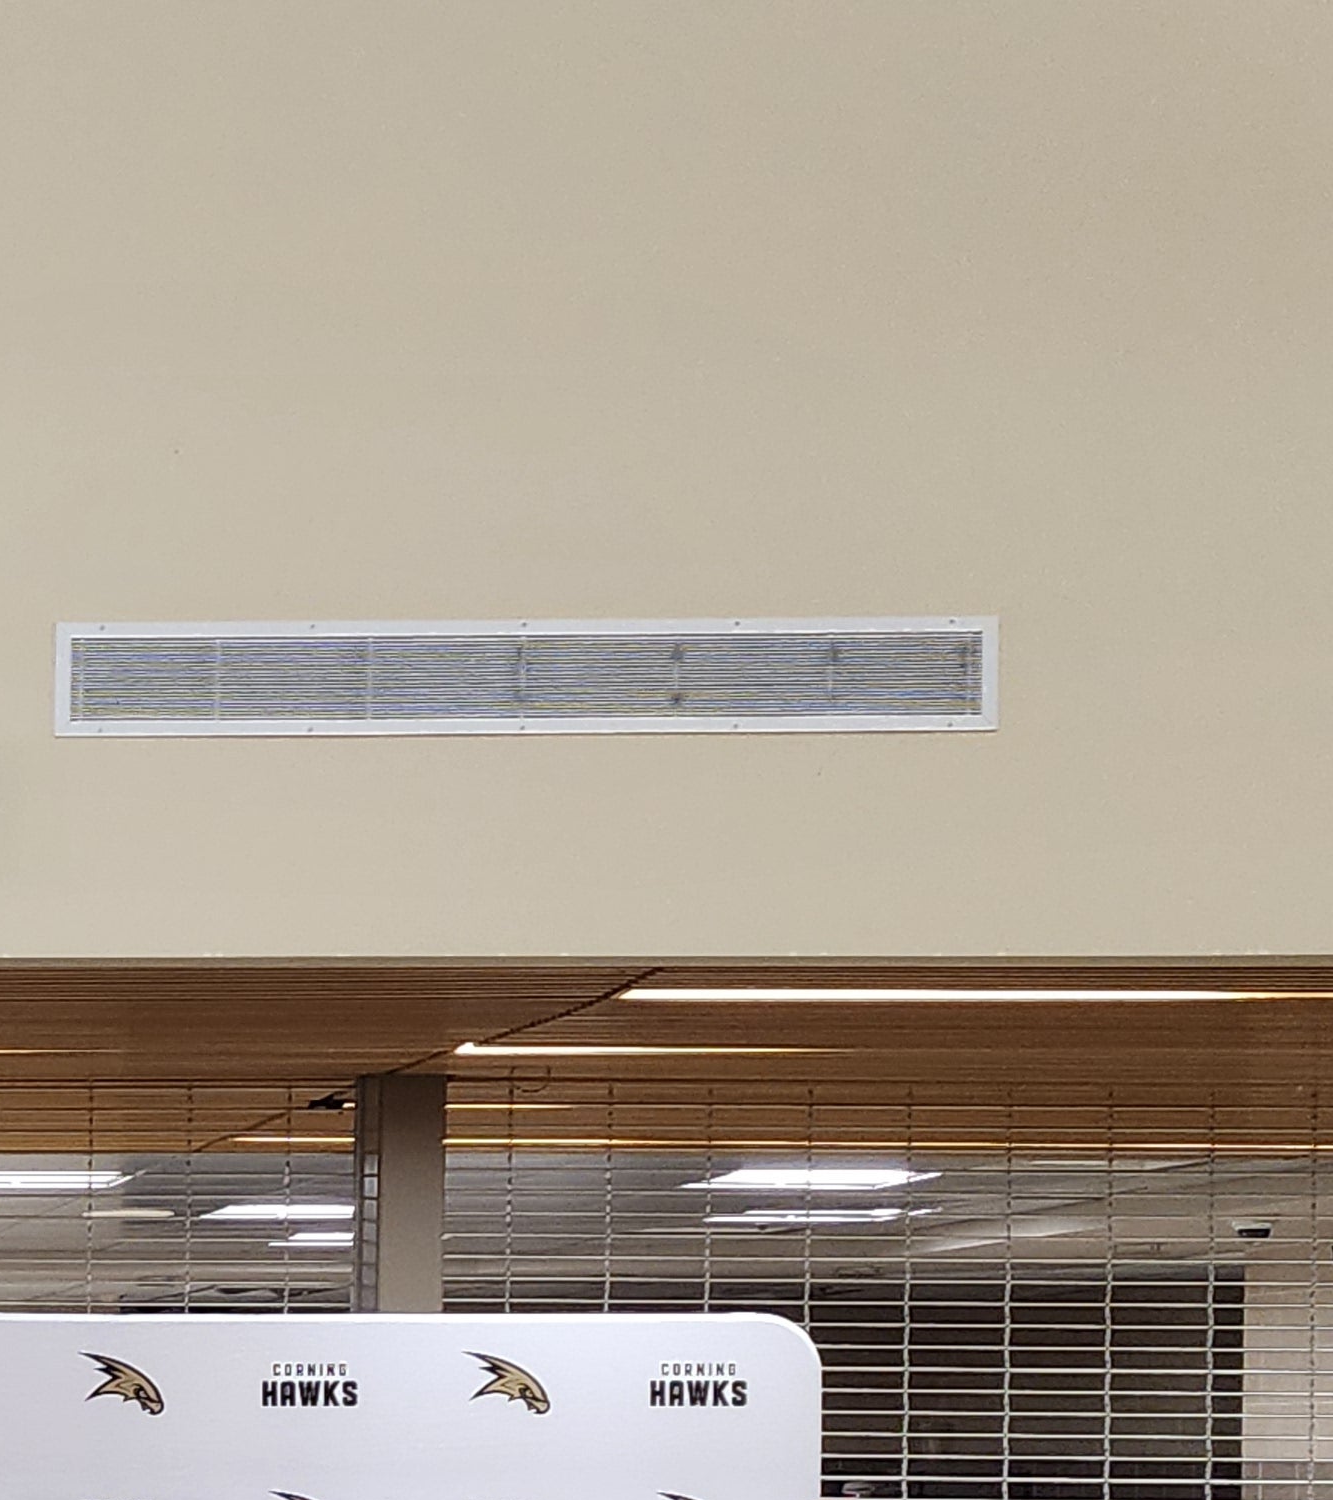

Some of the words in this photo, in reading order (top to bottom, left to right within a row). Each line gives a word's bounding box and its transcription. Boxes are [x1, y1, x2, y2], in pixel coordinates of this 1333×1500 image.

[273, 1363, 346, 1376] CORNING
[662, 1363, 735, 1375] CORNING
[262, 1380, 357, 1407] HAWKS
[650, 1380, 747, 1407] HAWKS
